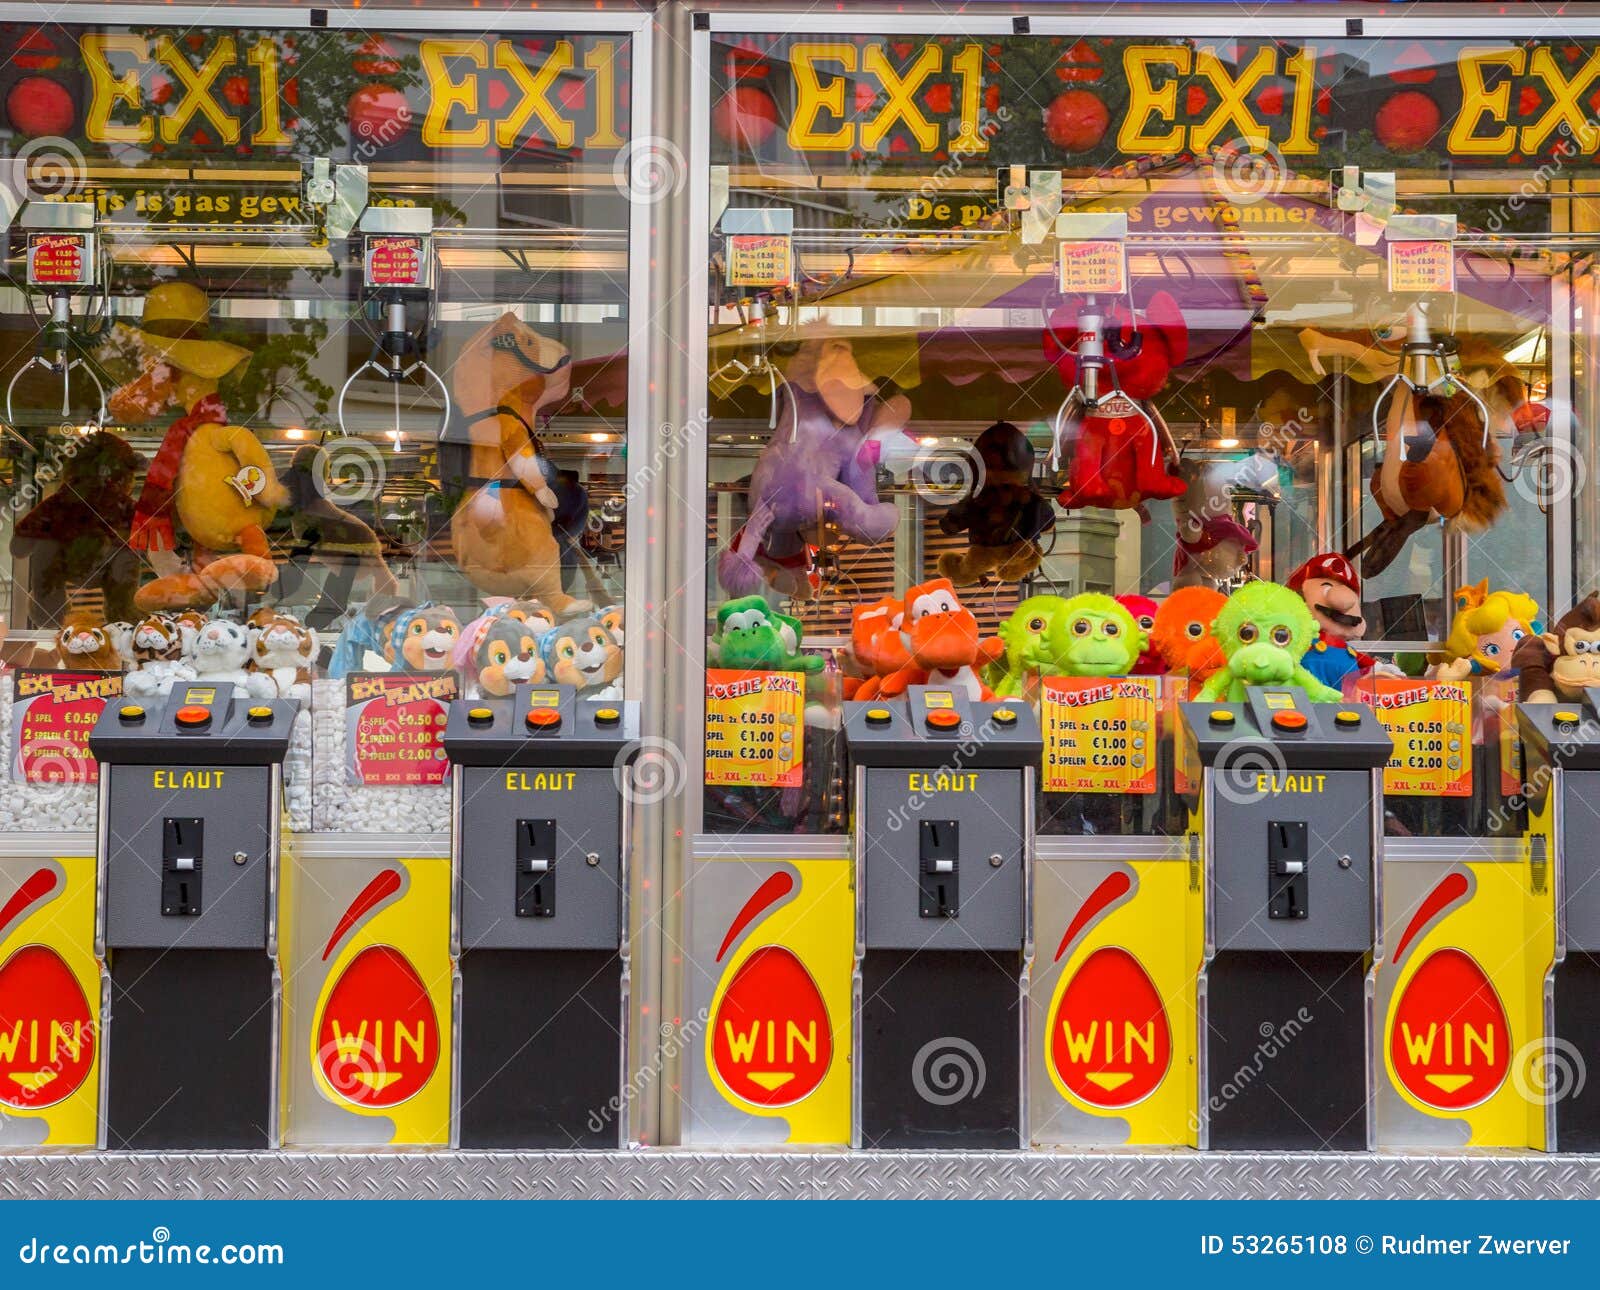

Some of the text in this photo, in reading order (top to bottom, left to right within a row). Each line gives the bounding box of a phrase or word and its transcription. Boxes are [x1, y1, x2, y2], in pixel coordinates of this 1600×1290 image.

[135, 190, 163, 212] is
[173, 194, 230, 217] pas
[907, 198, 951, 220] De
[1098, 402, 1130, 413] LOVE
[766, 675, 801, 696] XXL
[1117, 682, 1153, 704] XXL
[1432, 684, 1469, 704] XXL
[35, 713, 52, 722] SPEL
[707, 713, 724, 723] SPEL
[1059, 721, 1077, 731] SPEL
[24, 729, 31, 739] 2
[706, 731, 724, 740] SPEL
[1059, 739, 1077, 748] SPEL
[706, 749, 733, 759] SPELEN
[1049, 753, 1056, 765] 3
[1059, 756, 1087, 766] SPELEN
[153, 770, 225, 789] ELAUT
[506, 772, 576, 791] ELAUT
[724, 772, 740, 781] XXL
[750, 773, 766, 782] XXL
[908, 773, 979, 791] ELAUT
[1052, 779, 1068, 787] XXL
[1078, 779, 1094, 788] XXL
[1104, 780, 1120, 789] XXL
[1256, 774, 1327, 793] ELAUT
[1394, 781, 1410, 790] XXL
[1420, 782, 1436, 791] XXL
[332, 1019, 426, 1064] WIN
[724, 1020, 816, 1064] WIN
[1063, 1020, 1155, 1064] WIN
[1401, 1022, 1495, 1066] WIN
